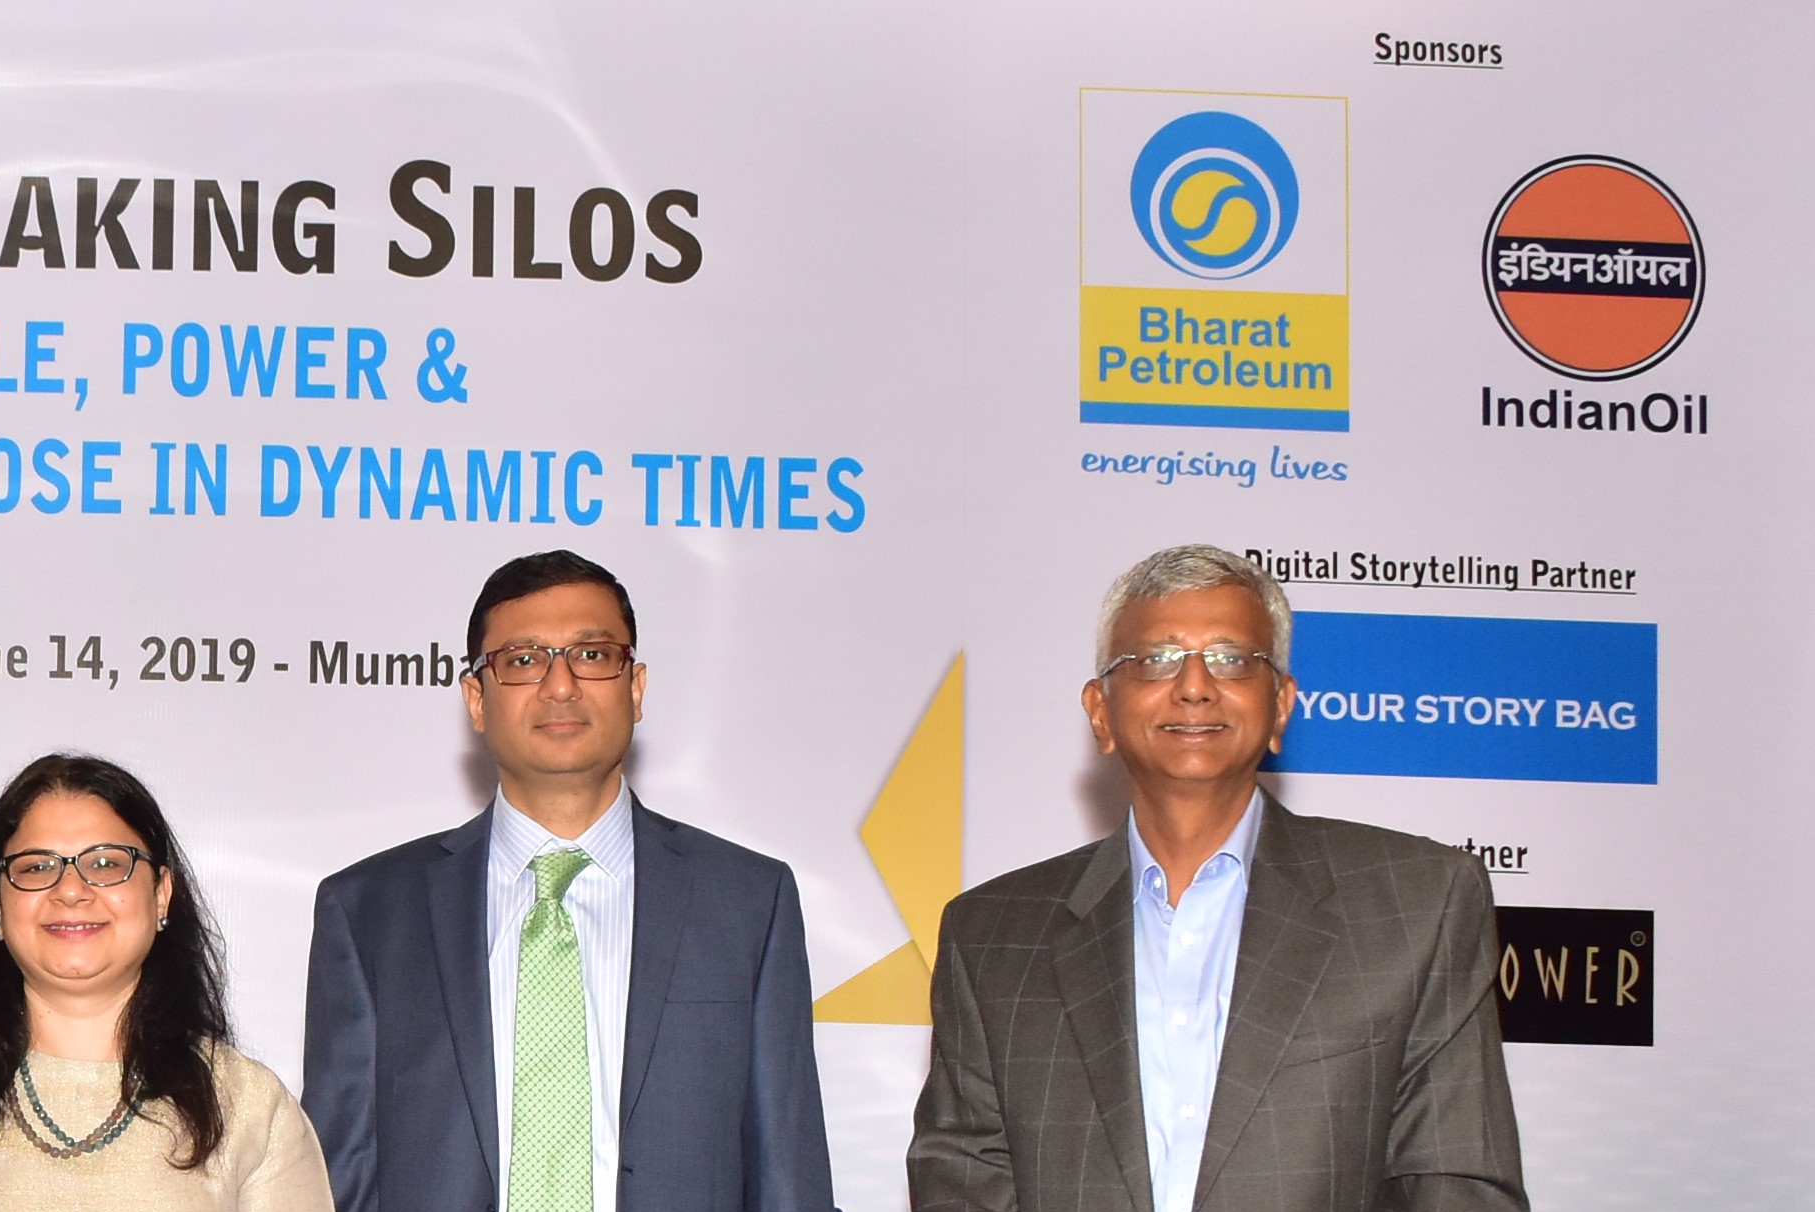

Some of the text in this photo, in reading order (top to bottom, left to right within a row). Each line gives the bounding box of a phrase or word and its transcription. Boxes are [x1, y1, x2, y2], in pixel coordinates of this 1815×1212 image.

[1375, 33, 1502, 65] Sponsors
[388, 160, 702, 284] SILOS
[1140, 307, 1290, 349] Bharat
[123, 322, 387, 400] POWER
[417, 328, 468, 403] &
[1099, 346, 1332, 390] Petroleum
[1483, 386, 1707, 434] IndianOil
[149, 443, 227, 516] IN
[261, 445, 603, 526] DYNAMIC
[632, 454, 865, 533] TIMES
[1081, 445, 1347, 488] energising lives
[1351, 552, 1519, 591] Storytelling
[1528, 559, 1635, 591] Partner
[49, 635, 118, 690] 14,
[140, 637, 255, 682] 2019
[1296, 690, 1635, 730] YOUR STORY BAG
[1499, 943, 1640, 1007] OWER
